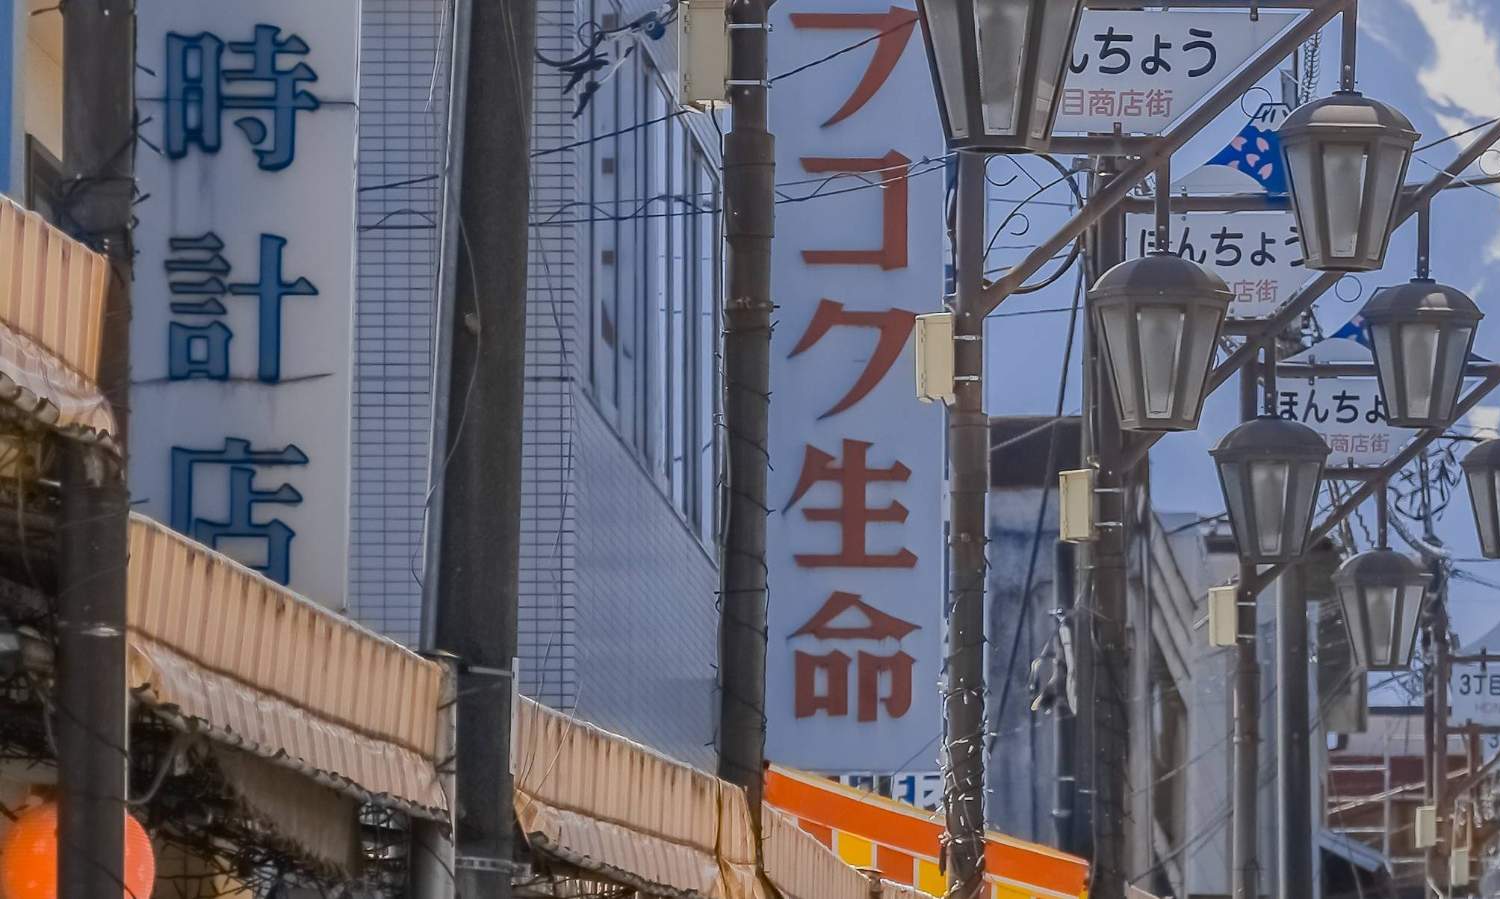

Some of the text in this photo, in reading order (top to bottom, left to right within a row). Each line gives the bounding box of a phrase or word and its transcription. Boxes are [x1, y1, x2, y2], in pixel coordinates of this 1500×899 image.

[164, 24, 320, 585] 時計店
[782, 6, 922, 723] フコク生命
[1226, 279, 1279, 303] 店街
[1318, 433, 1390, 453] 商店街
